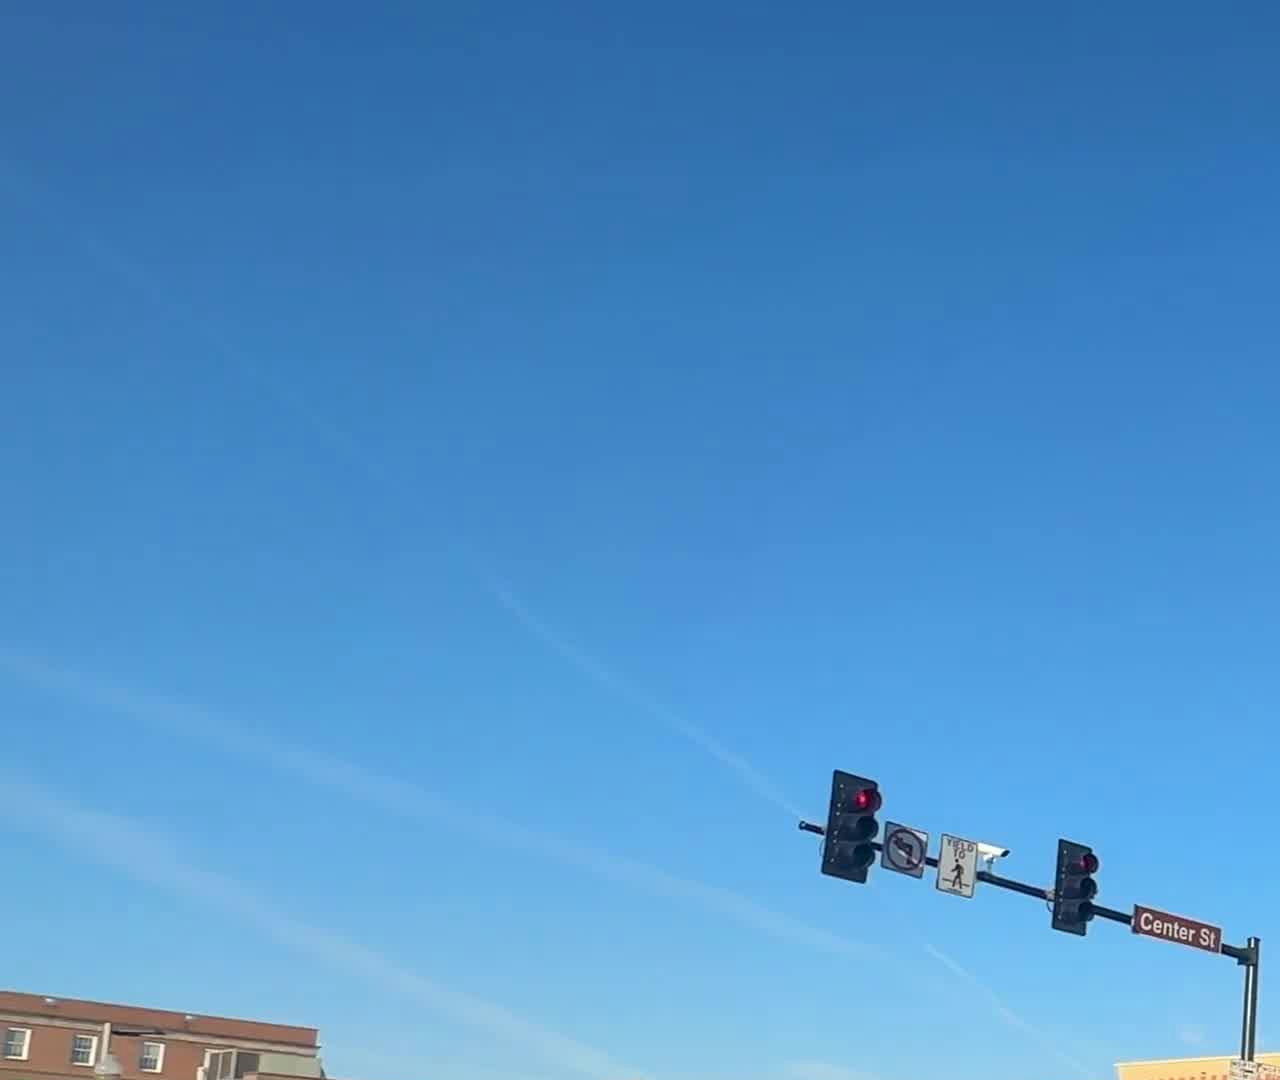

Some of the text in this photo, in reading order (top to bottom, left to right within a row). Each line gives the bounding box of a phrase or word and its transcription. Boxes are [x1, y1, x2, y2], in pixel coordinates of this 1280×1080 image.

[953, 848, 966, 859] TO
[1140, 912, 1216, 947] Center St
